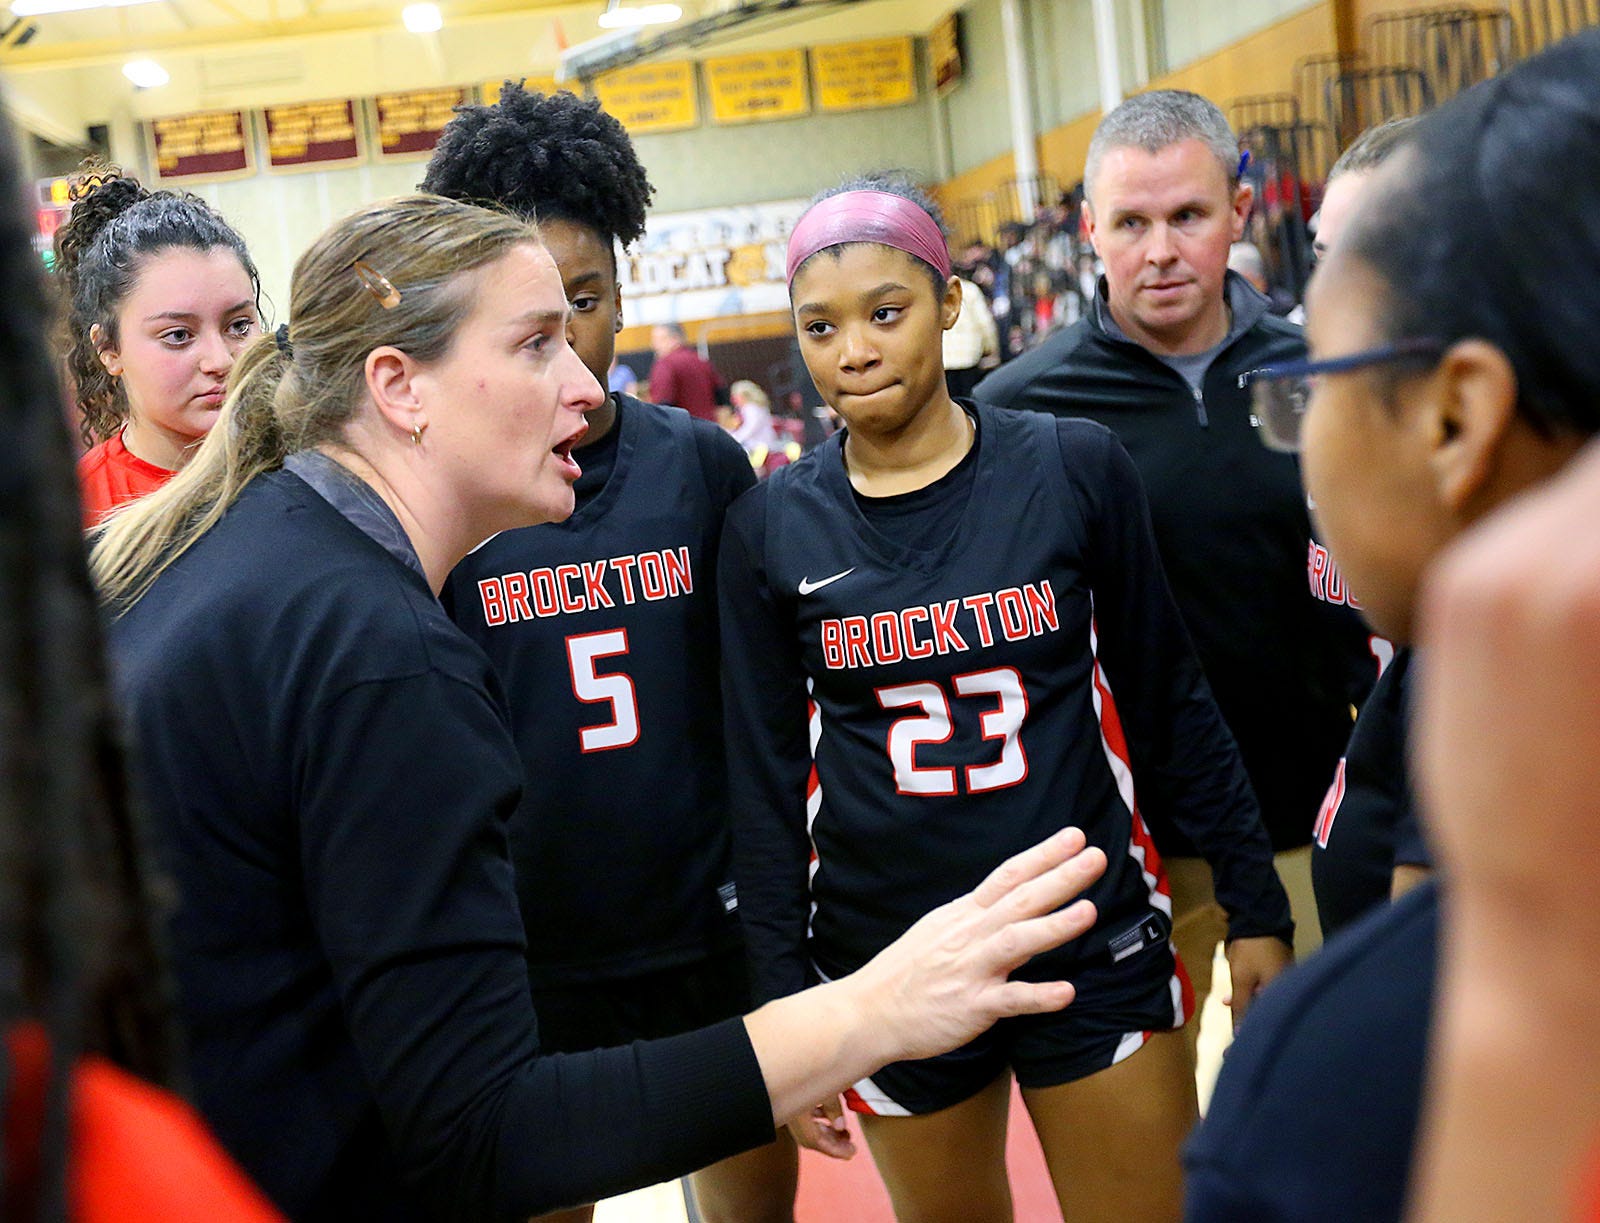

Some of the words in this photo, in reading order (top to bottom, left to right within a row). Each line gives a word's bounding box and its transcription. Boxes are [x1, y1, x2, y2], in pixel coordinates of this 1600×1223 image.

[477, 546, 694, 627] BROCKTON
[821, 579, 1060, 670] BROCKTON
[564, 627, 641, 754] 5
[873, 665, 1030, 797] 23
[1147, 925, 1159, 940] L
